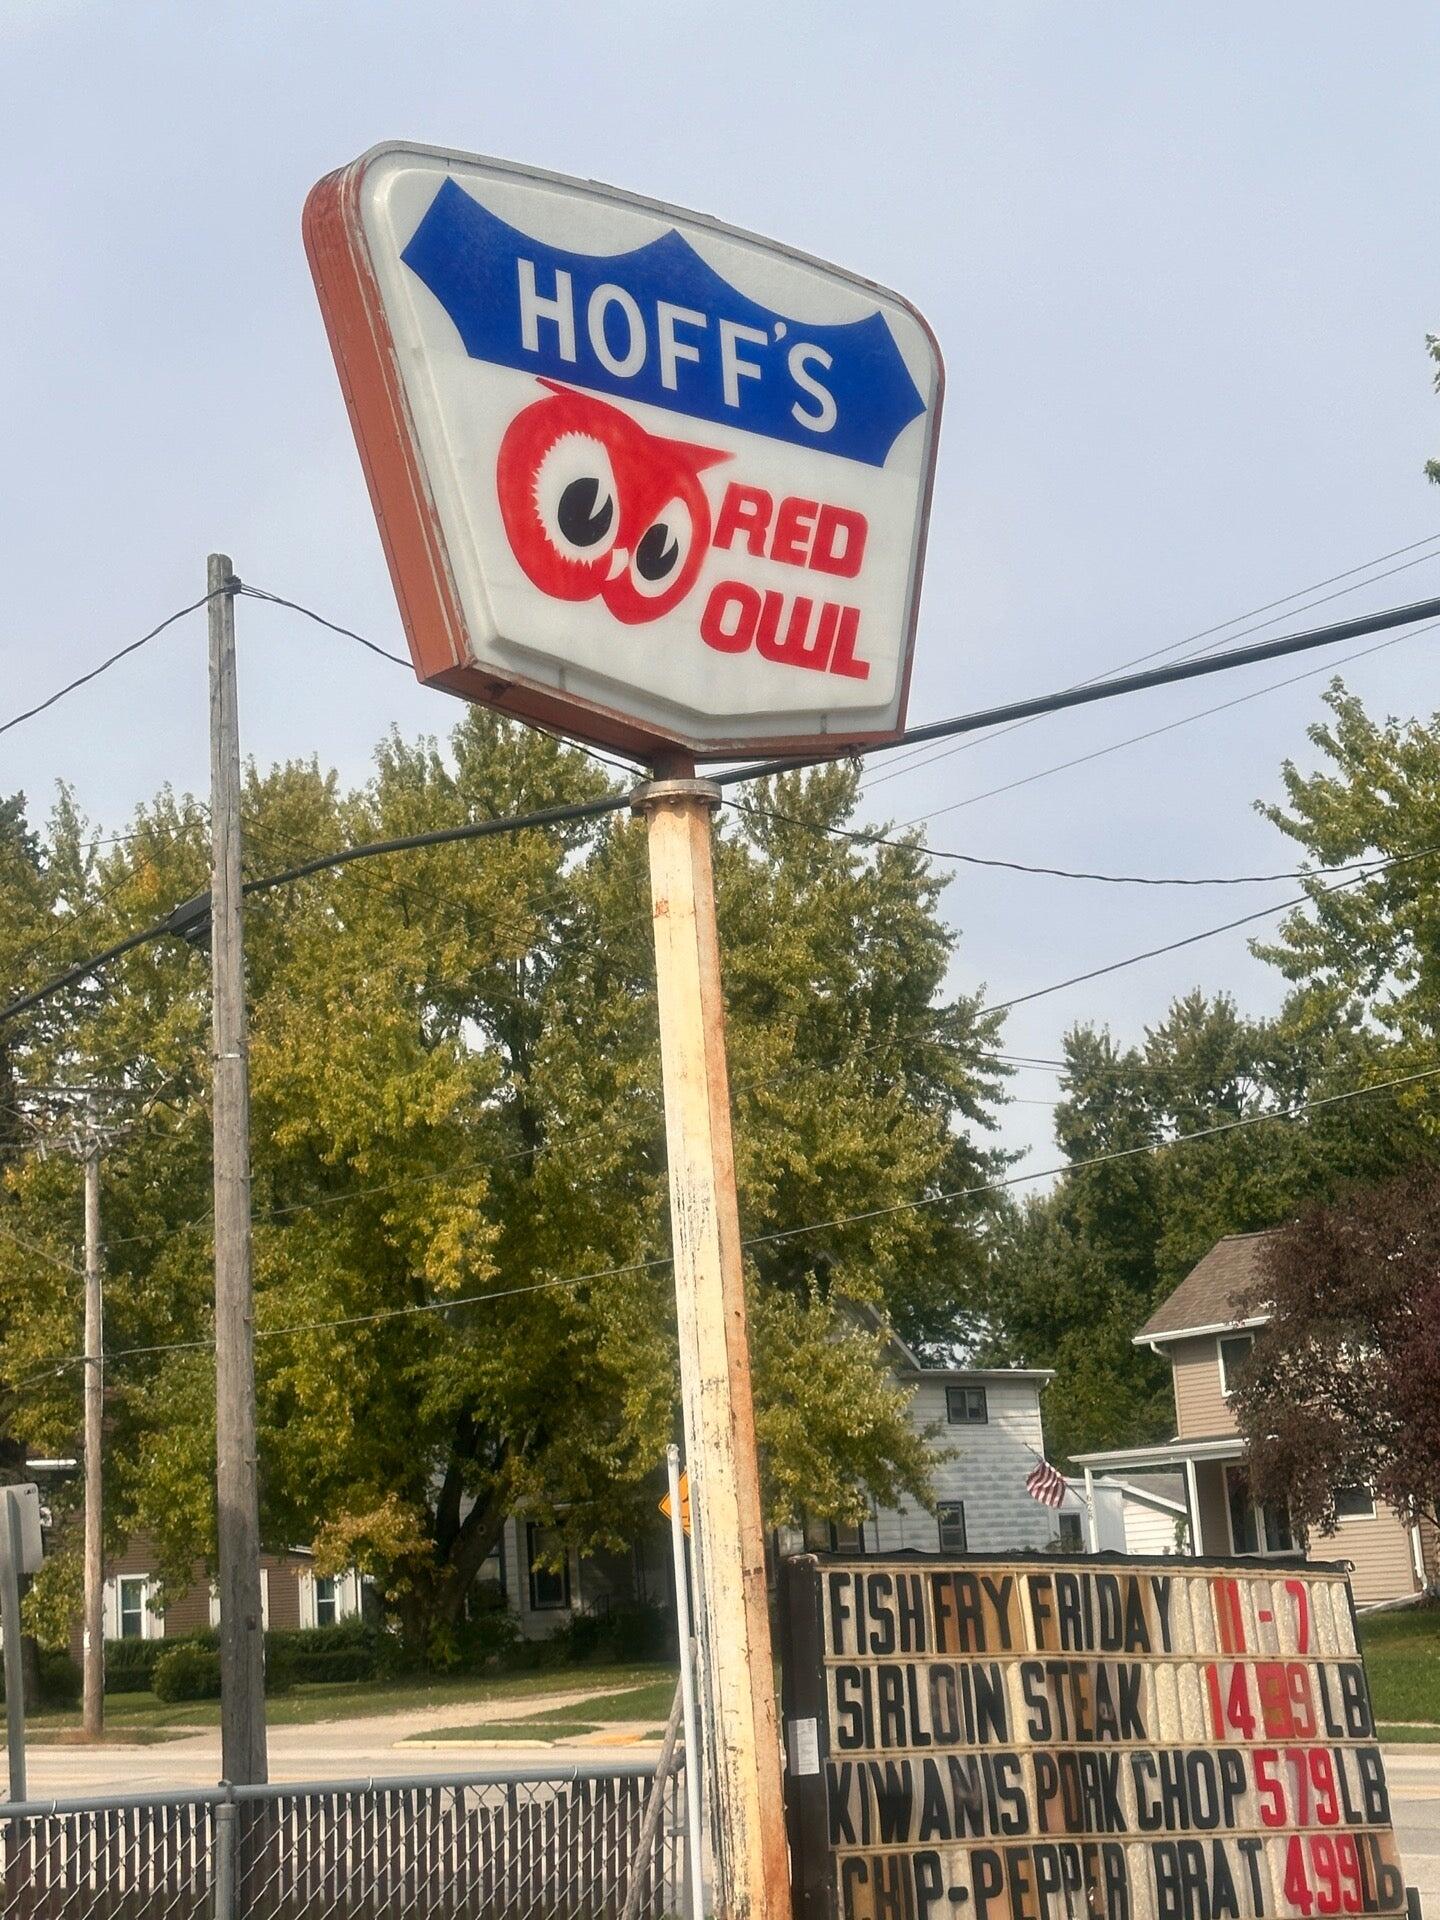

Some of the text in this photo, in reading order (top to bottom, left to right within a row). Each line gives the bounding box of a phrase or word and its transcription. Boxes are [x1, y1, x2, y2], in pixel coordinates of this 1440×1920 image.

[517, 258, 838, 433] HOFF'S
[712, 482, 869, 579] RED
[700, 580, 871, 680] OWL
[829, 1572, 926, 1656] FISH
[931, 1572, 1014, 1654] FRY
[1027, 1572, 1172, 1654] FRIDAY
[835, 1663, 1009, 1750] SIRLOIN
[1020, 1661, 1147, 1742] STEAK
[826, 1752, 1030, 1846] KIWANIS
[1033, 1750, 1128, 1834] PORK
[1130, 1748, 1248, 1832] CHOP
[1152, 1838, 1265, 1920] BRAT
